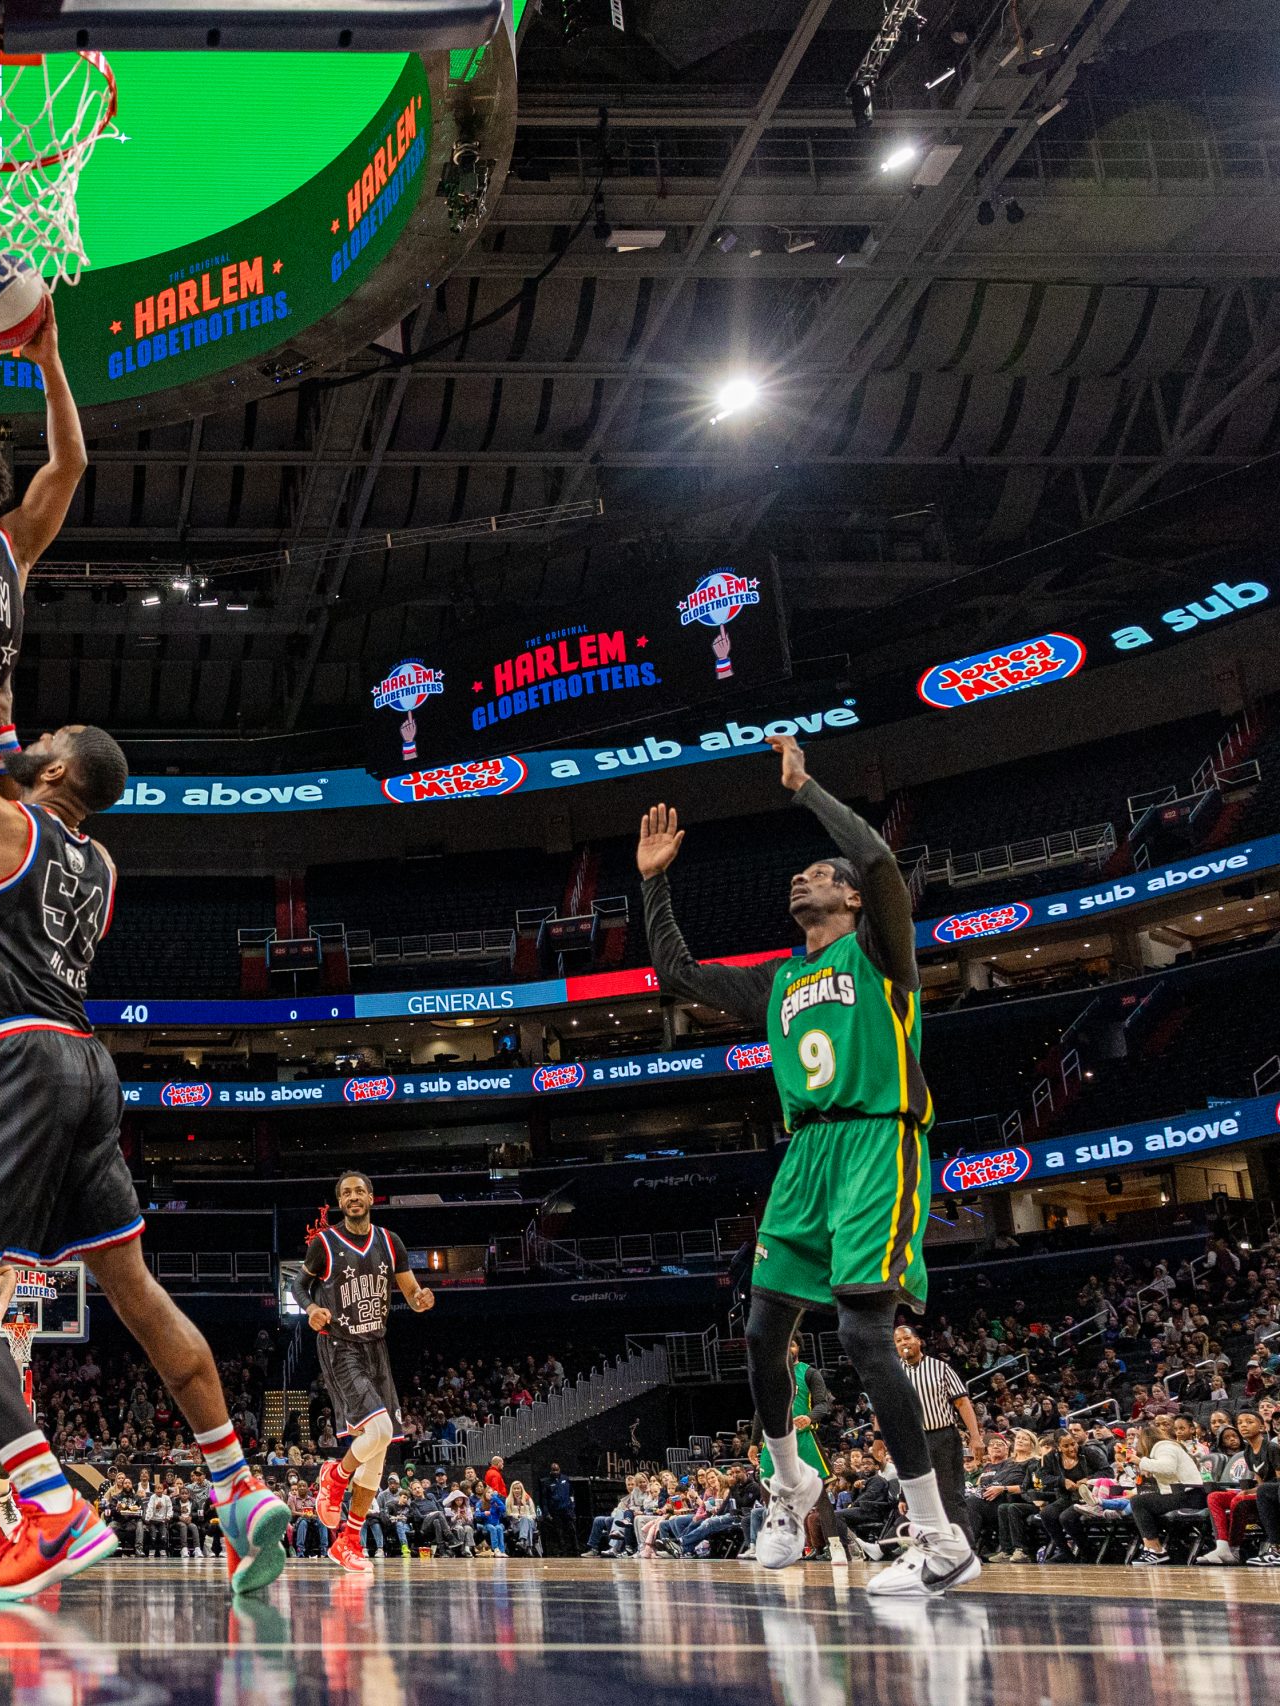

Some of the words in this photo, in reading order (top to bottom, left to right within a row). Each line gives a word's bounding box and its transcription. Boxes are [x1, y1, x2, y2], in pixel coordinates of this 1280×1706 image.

[347, 96, 416, 232] HARLEM
[134, 256, 264, 339] HARLEM
[108, 290, 288, 380] GLOBETROTTERS
[688, 577, 747, 609] HARLEM
[682, 592, 758, 624] GLOBETROTTERS
[1111, 626, 1153, 650] a
[1161, 581, 1270, 633] sub
[525, 637, 541, 648] THE
[546, 624, 588, 641] ORIGINAL
[494, 630, 627, 696] HARLEM
[939, 640, 1054, 690] Jersey
[382, 669, 433, 694] HARLEM
[956, 660, 1066, 703] Mike's
[375, 683, 443, 707] GLOBETROTTERS
[551, 760, 580, 778] a
[594, 736, 682, 771] sub
[401, 758, 504, 786] Jersey
[115, 783, 166, 806] ub
[414, 774, 506, 801] Mike's
[1048, 903, 1068, 917] a
[1079, 885, 1135, 909] sub
[947, 906, 1016, 932] Jersey
[954, 916, 1018, 940] Mike's
[121, 1005, 149, 1024] 40
[290, 1010, 297, 1020] 0
[332, 1007, 339, 1017] 0
[407, 990, 514, 1014] GENERALS
[593, 1068, 603, 1080] a
[609, 1063, 641, 1079] sub
[798, 1029, 836, 1090] 9
[350, 1078, 387, 1092] Jersey
[403, 1081, 414, 1093] a
[420, 1077, 451, 1093] sub
[541, 1066, 577, 1080] Jersey
[168, 1085, 204, 1096] Jersey
[220, 1091, 229, 1101] a
[235, 1088, 265, 1102] sub
[953, 1151, 1016, 1177] Jersey
[1045, 1151, 1064, 1168] a
[1075, 1136, 1133, 1162] sub
[961, 1163, 1019, 1189] Mike's
